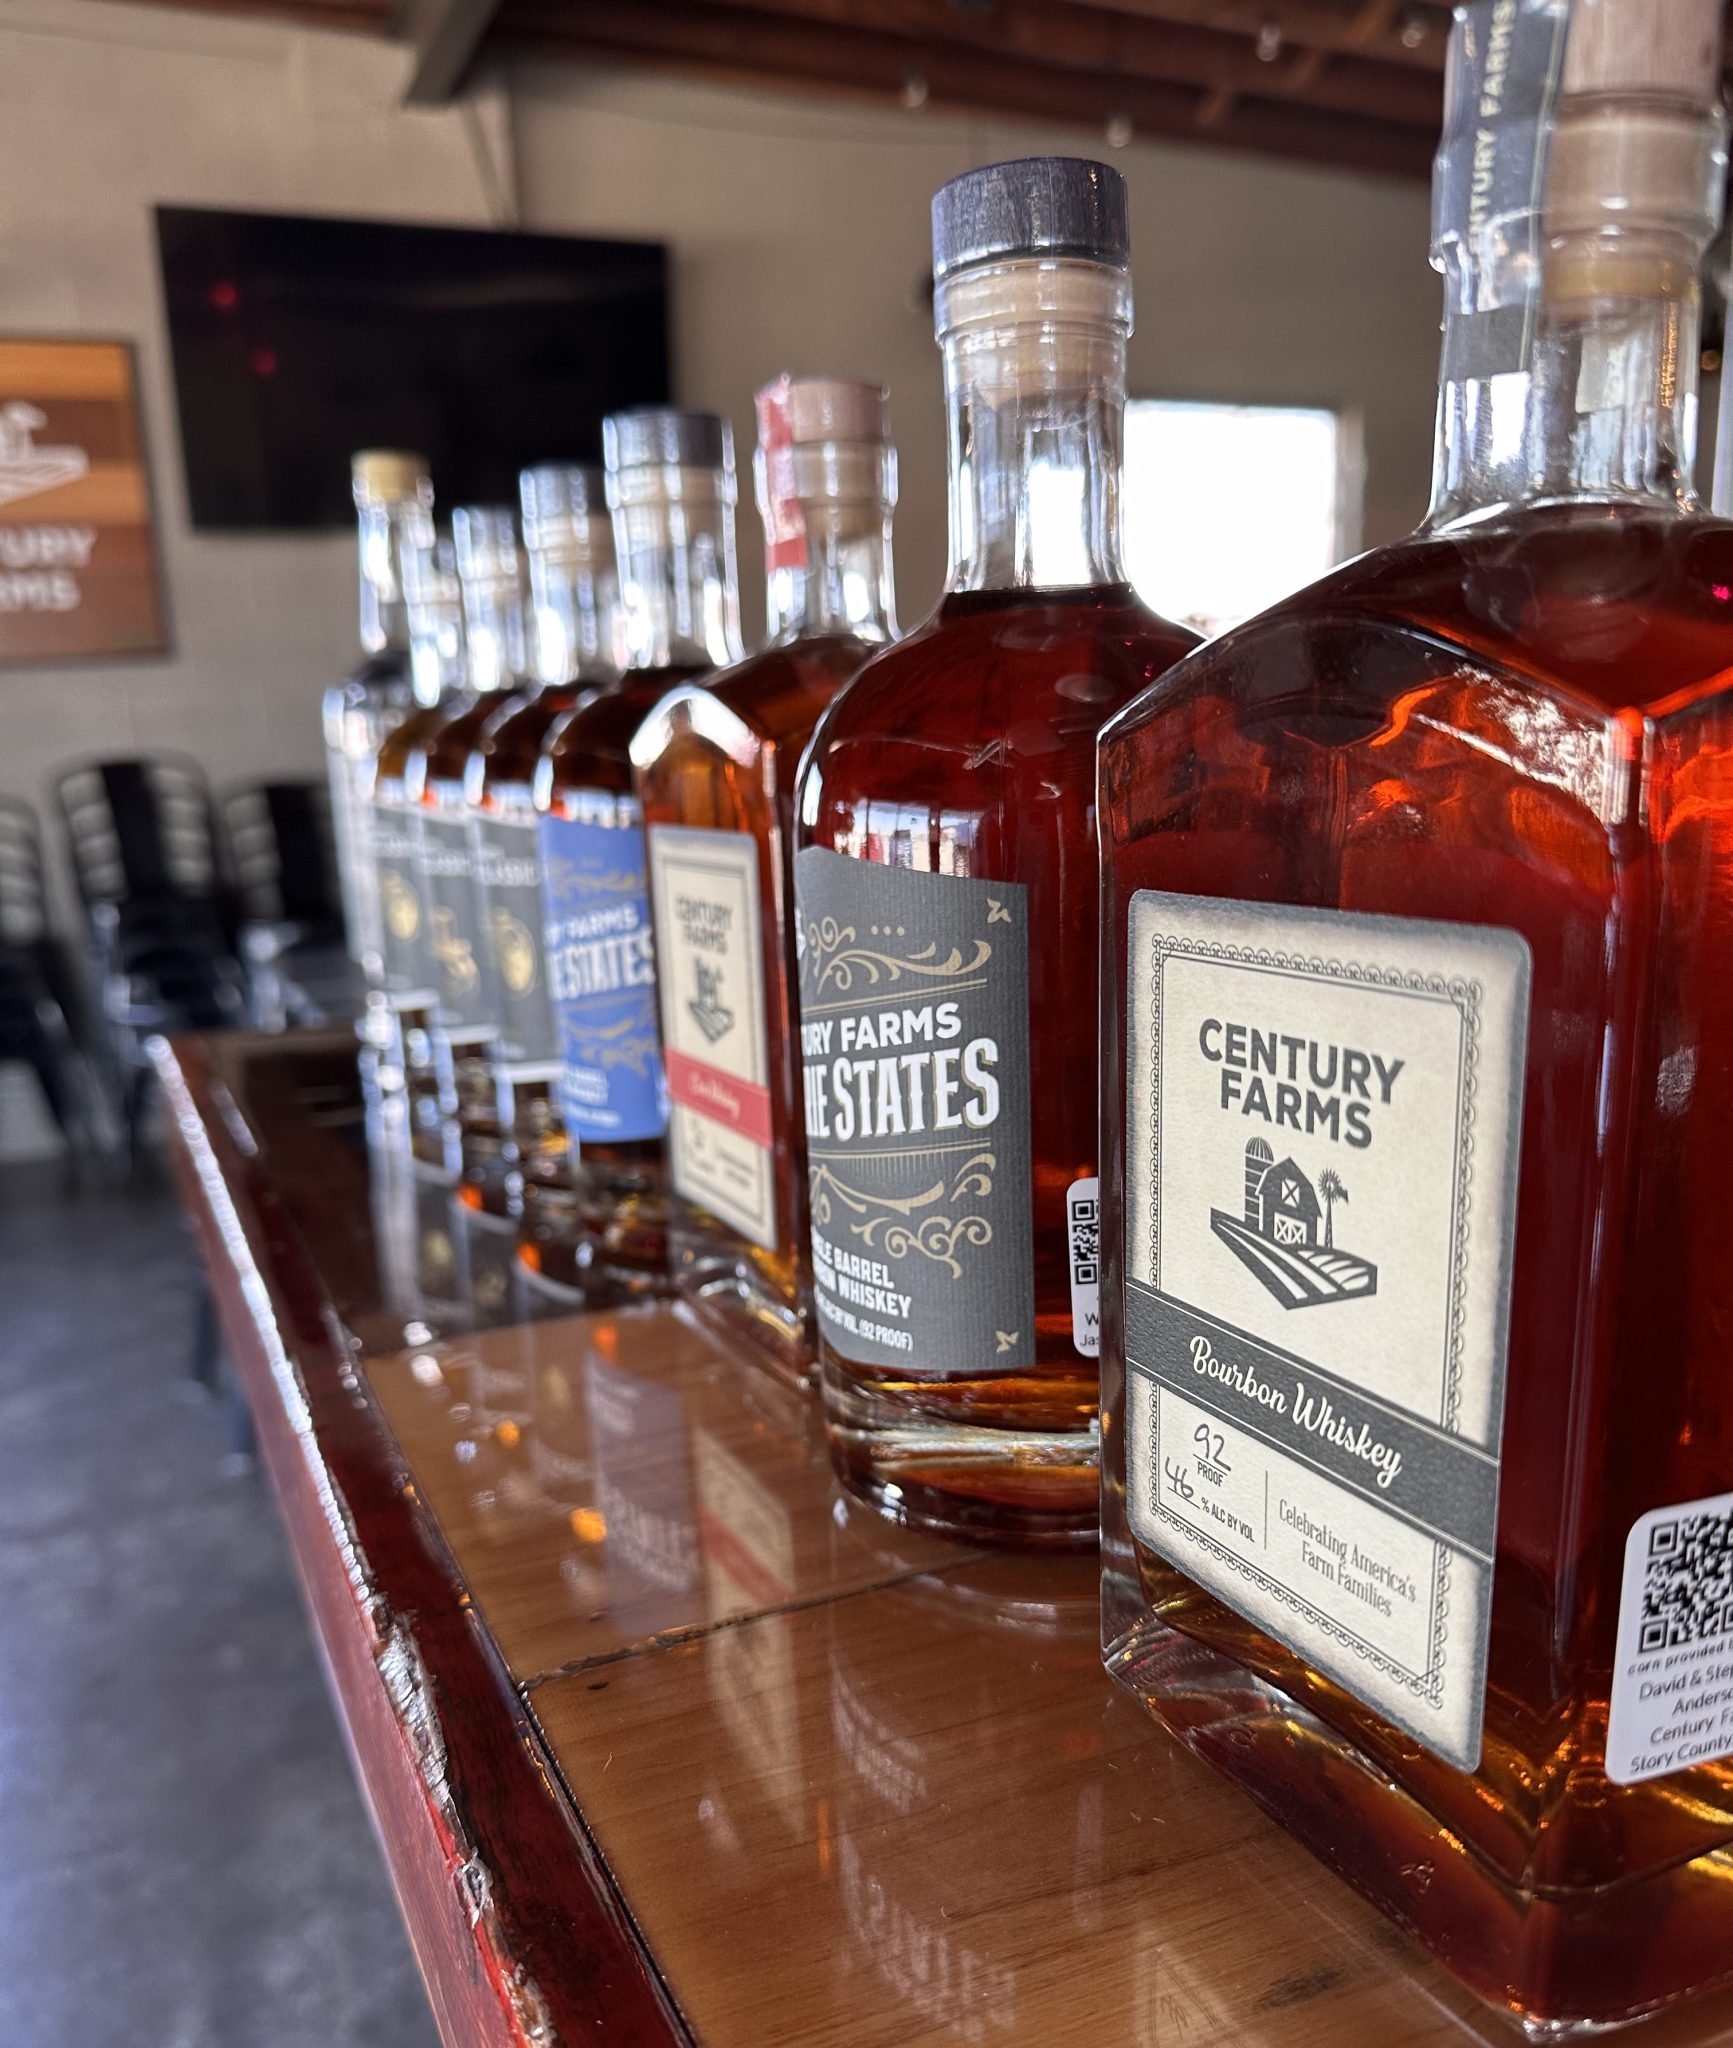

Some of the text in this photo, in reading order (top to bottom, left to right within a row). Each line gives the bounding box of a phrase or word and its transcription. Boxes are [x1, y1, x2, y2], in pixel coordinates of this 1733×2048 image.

[840, 1002, 962, 1053] FARMS
[1199, 1018, 1405, 1104] CENTURY
[1220, 1069, 1372, 1149] FARMS
[833, 1246, 895, 1290] BARREL
[837, 1272, 912, 1319] WHISKEY
[1189, 1335, 1403, 1489] Bourbon Whiskey
[1194, 1423, 1232, 1472] 92
[1164, 1456, 1195, 1499] 46
[1197, 1460, 1224, 1488] PROOF
[1211, 1503, 1226, 1524] ALC
[1227, 1512, 1238, 1532] BY
[1239, 1520, 1255, 1543] VOL
[1279, 1498, 1417, 1603] Celebrating America's
[1301, 1540, 1392, 1617] Farm Families
[1628, 1660, 1660, 1676] corn
[1665, 1639, 1724, 1670] provided
[1639, 1673, 1687, 1700] David
[1689, 1669, 1702, 1687] &
[1649, 1716, 1715, 1745] Century
[1631, 1751, 1675, 1774] Story
